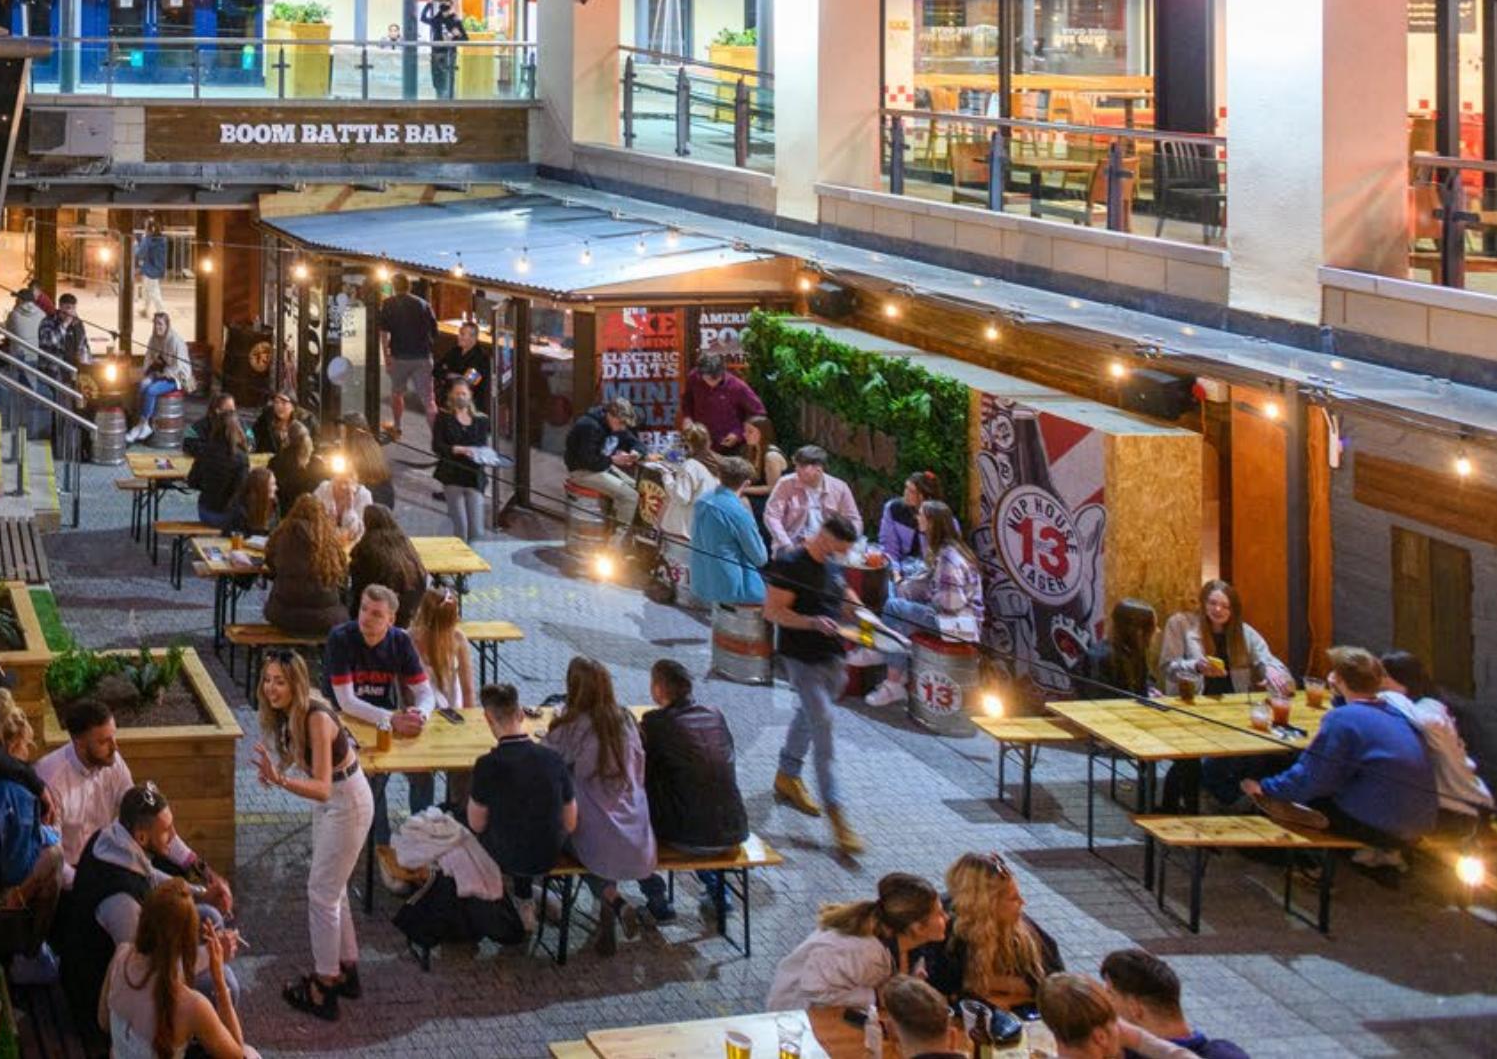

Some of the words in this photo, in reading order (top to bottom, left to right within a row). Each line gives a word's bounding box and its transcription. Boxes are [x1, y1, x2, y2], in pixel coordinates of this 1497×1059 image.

[220, 124, 295, 144] BOOM
[301, 124, 399, 144] BATTLE
[405, 124, 458, 144] BAR
[601, 351, 680, 364] ELECTRIC
[601, 363, 680, 379] DARTS
[603, 382, 680, 403] MINI
[1006, 497, 1029, 531] HOP
[1034, 497, 1079, 557] HOUSE
[1017, 518, 1070, 581] 13
[1018, 562, 1068, 593] LAGER
[921, 683, 954, 707] 13
